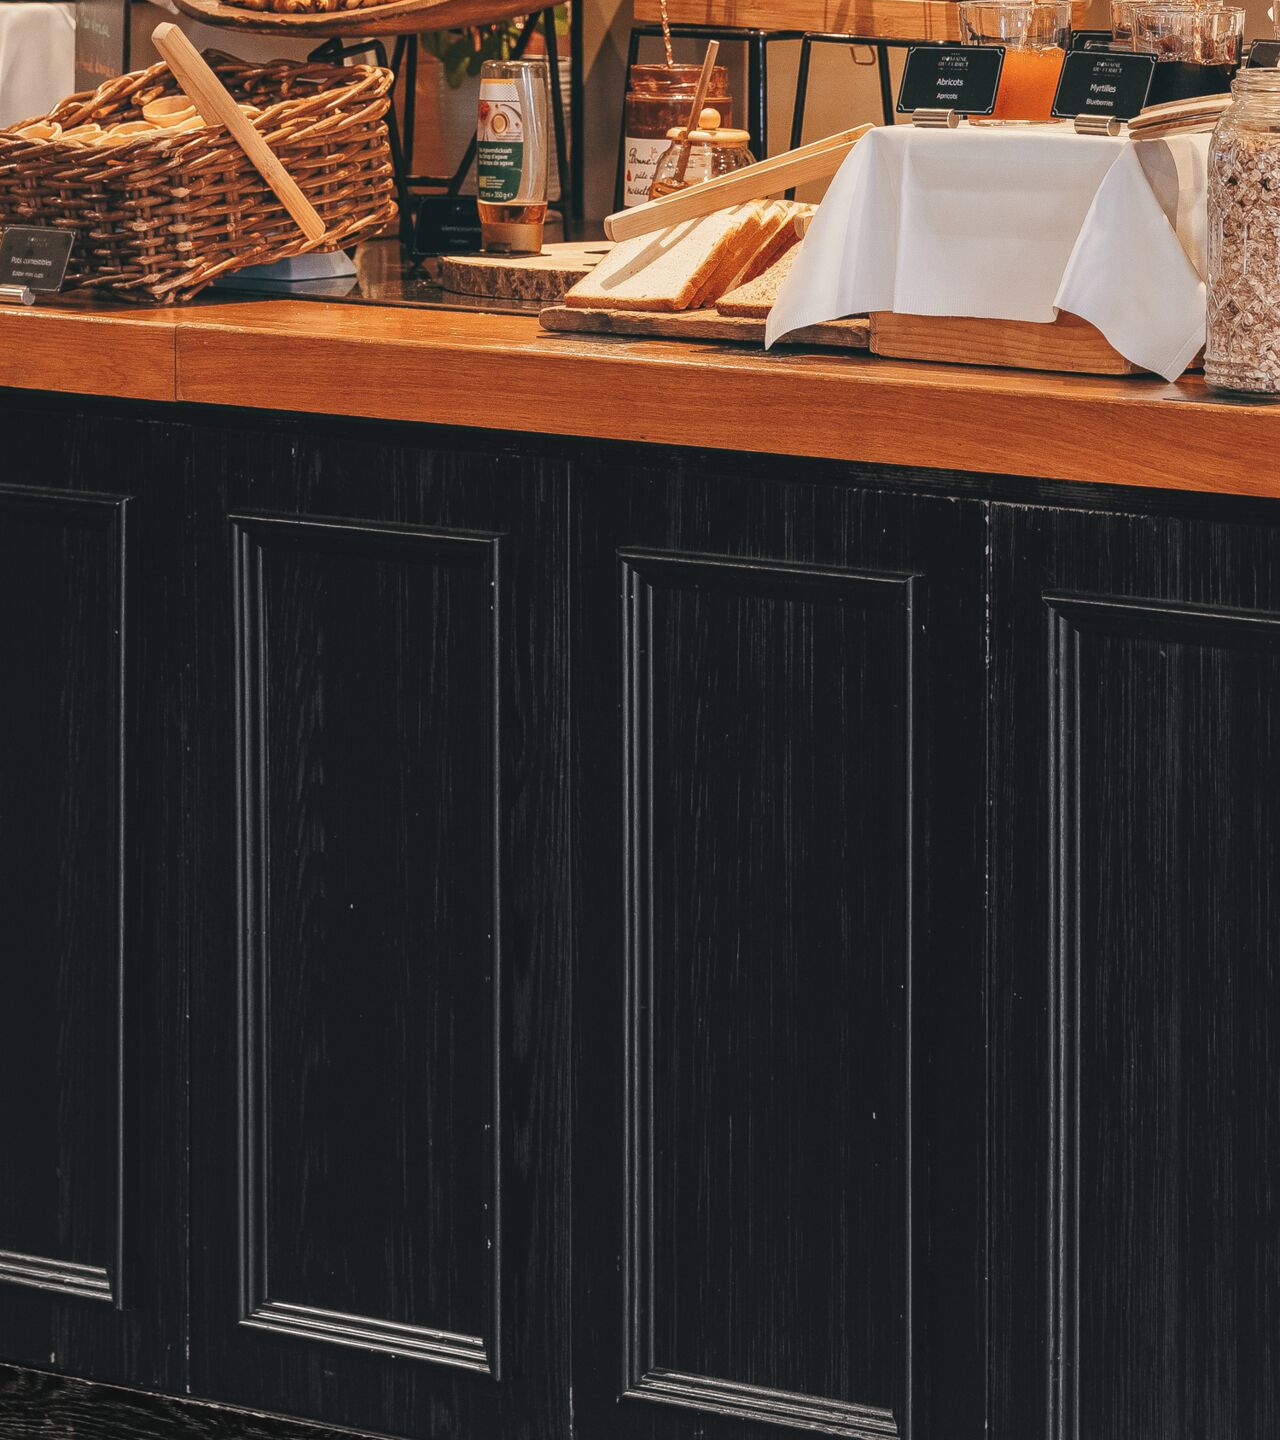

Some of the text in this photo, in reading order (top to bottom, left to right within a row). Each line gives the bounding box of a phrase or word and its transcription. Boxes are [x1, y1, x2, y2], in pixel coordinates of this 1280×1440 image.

[936, 77, 964, 87] Abricots
[1090, 83, 1117, 94] Myrtilles
[936, 92, 959, 100] Apricots
[10, 256, 52, 266] Pots comestibles
